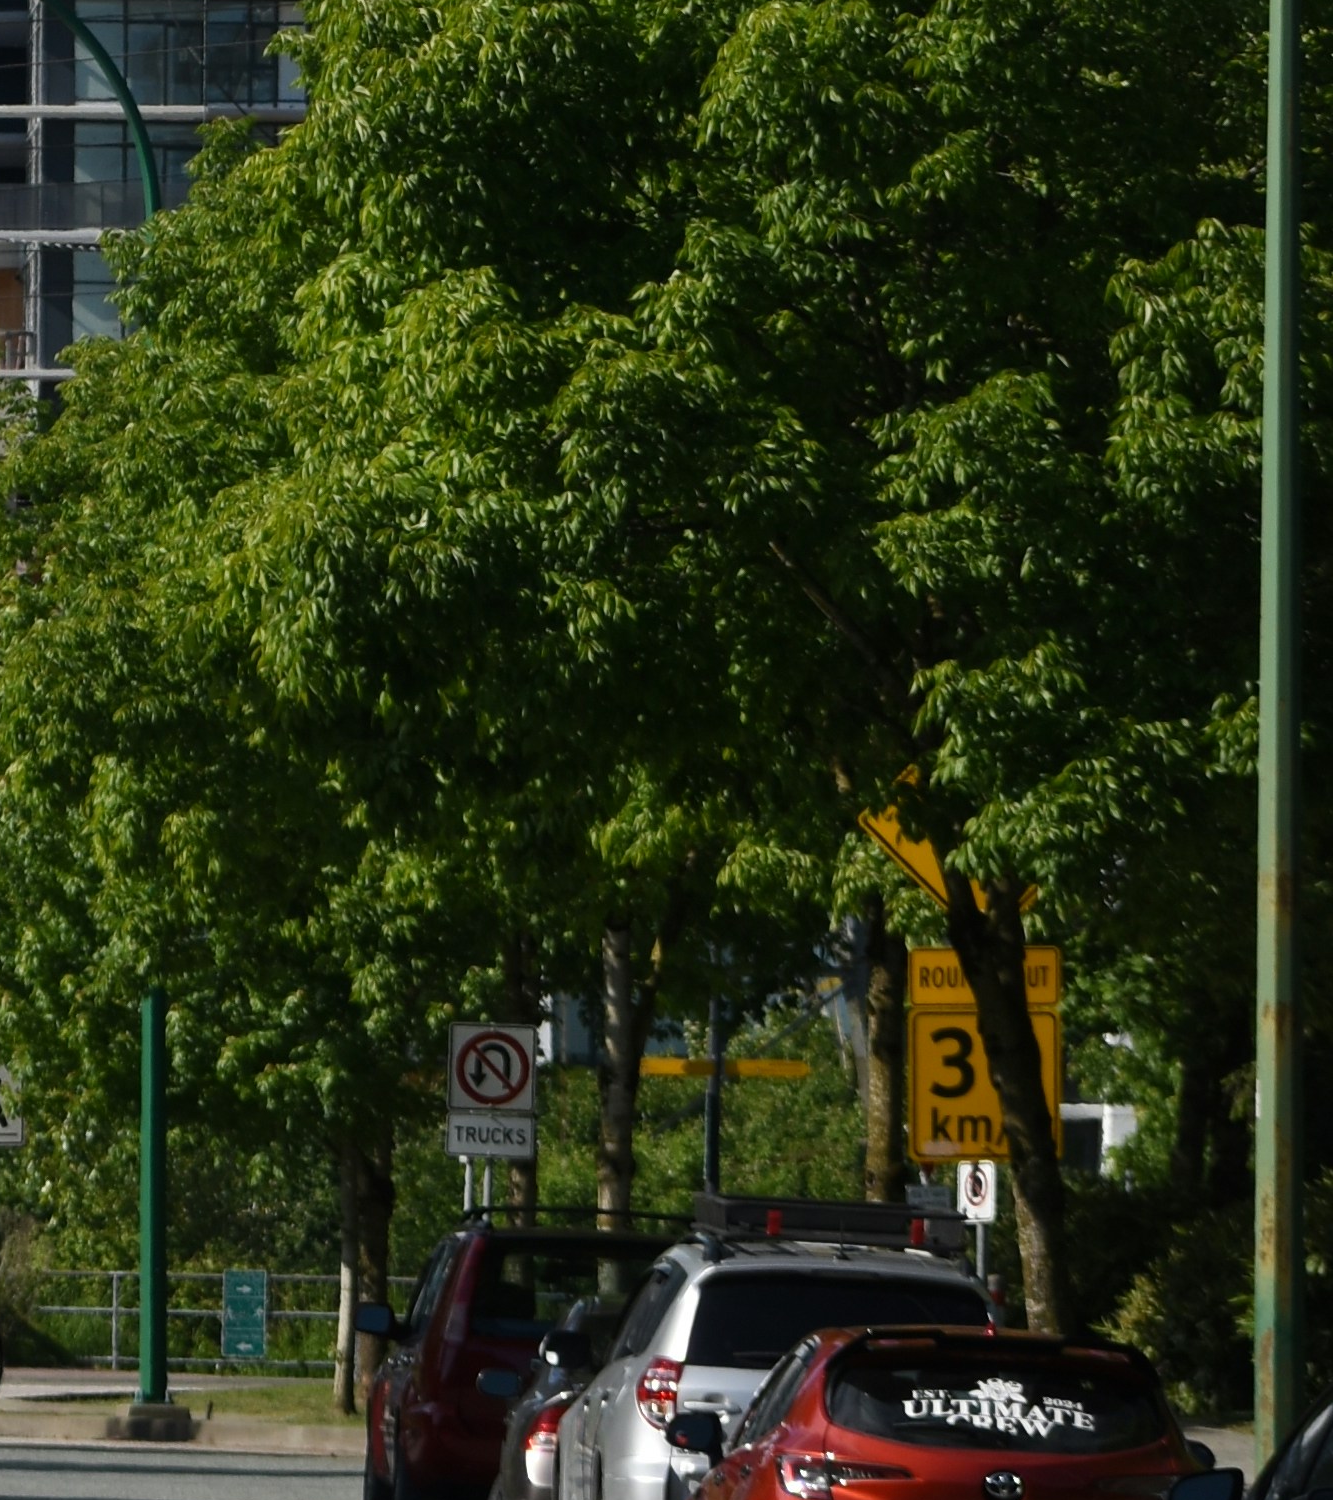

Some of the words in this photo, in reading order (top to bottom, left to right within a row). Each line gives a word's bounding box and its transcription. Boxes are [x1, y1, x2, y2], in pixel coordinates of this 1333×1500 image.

[919, 965, 1050, 988] ROUUT
[454, 1125, 526, 1145] TRUCKS
[1042, 1396, 1085, 1411] 2024
[902, 1399, 1096, 1432] ULTIMATE
[946, 1414, 1055, 1439] CREW
